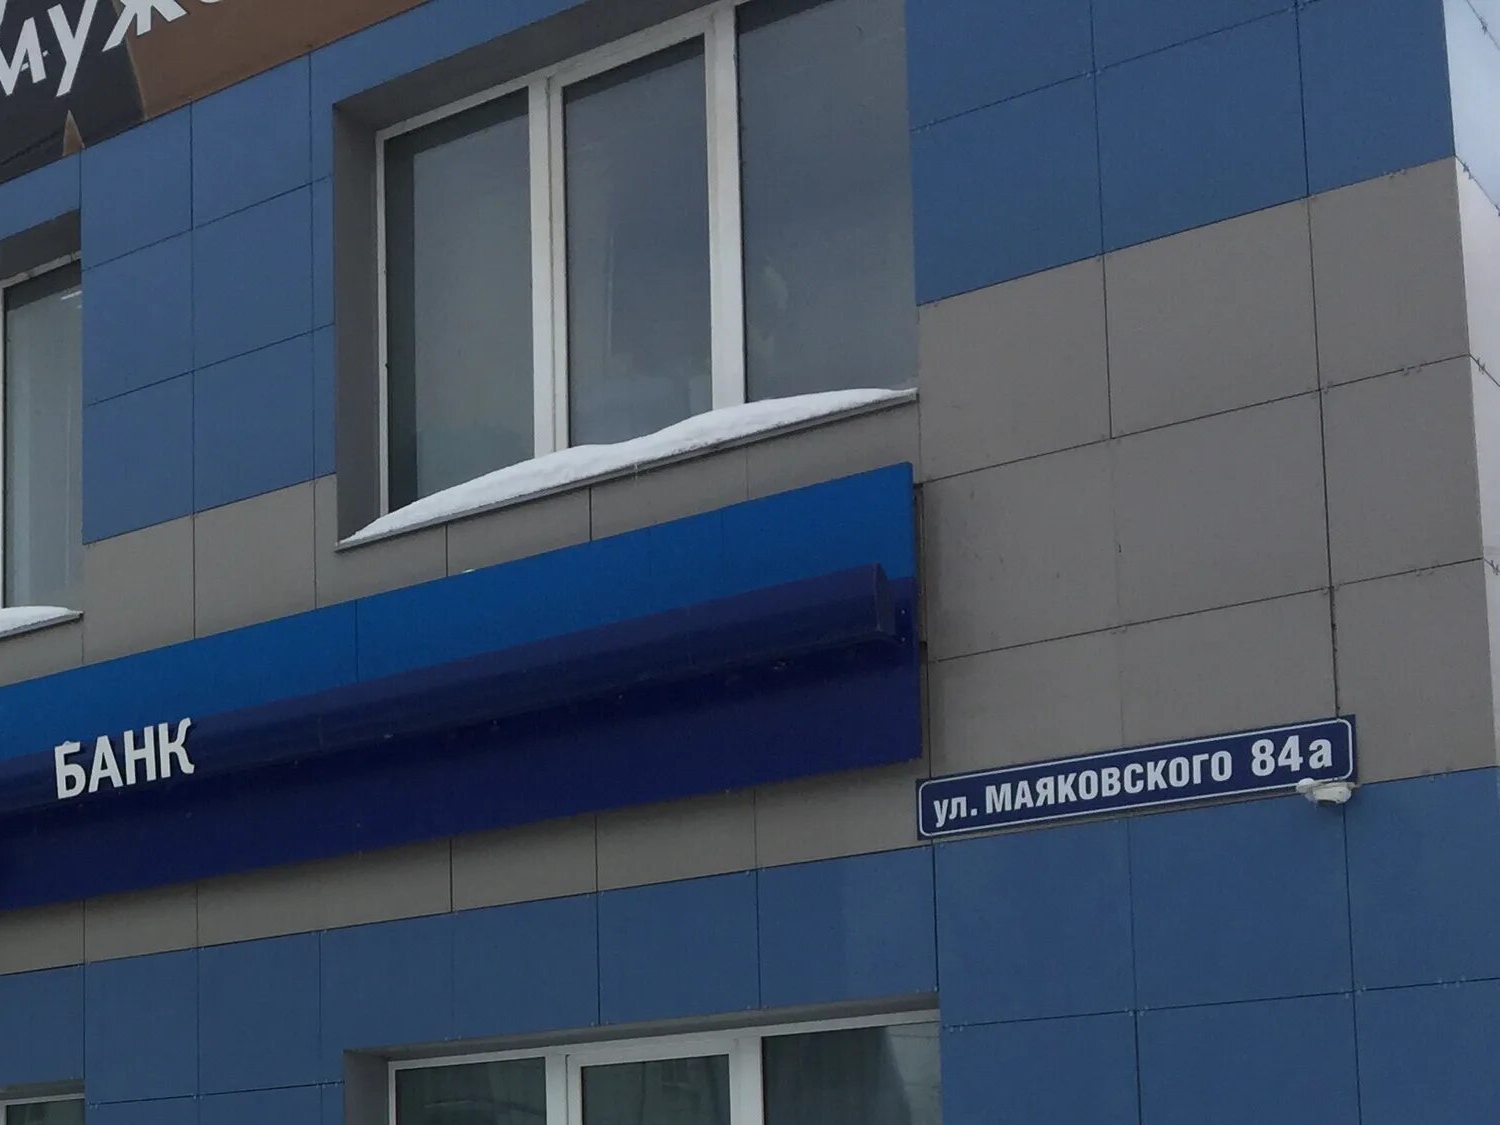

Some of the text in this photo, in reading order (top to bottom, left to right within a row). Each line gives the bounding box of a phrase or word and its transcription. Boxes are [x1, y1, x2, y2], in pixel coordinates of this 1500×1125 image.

[54, 717, 195, 799] БАНК
[933, 735, 1333, 828] ул. МАЯКОВСКОГО 84а
